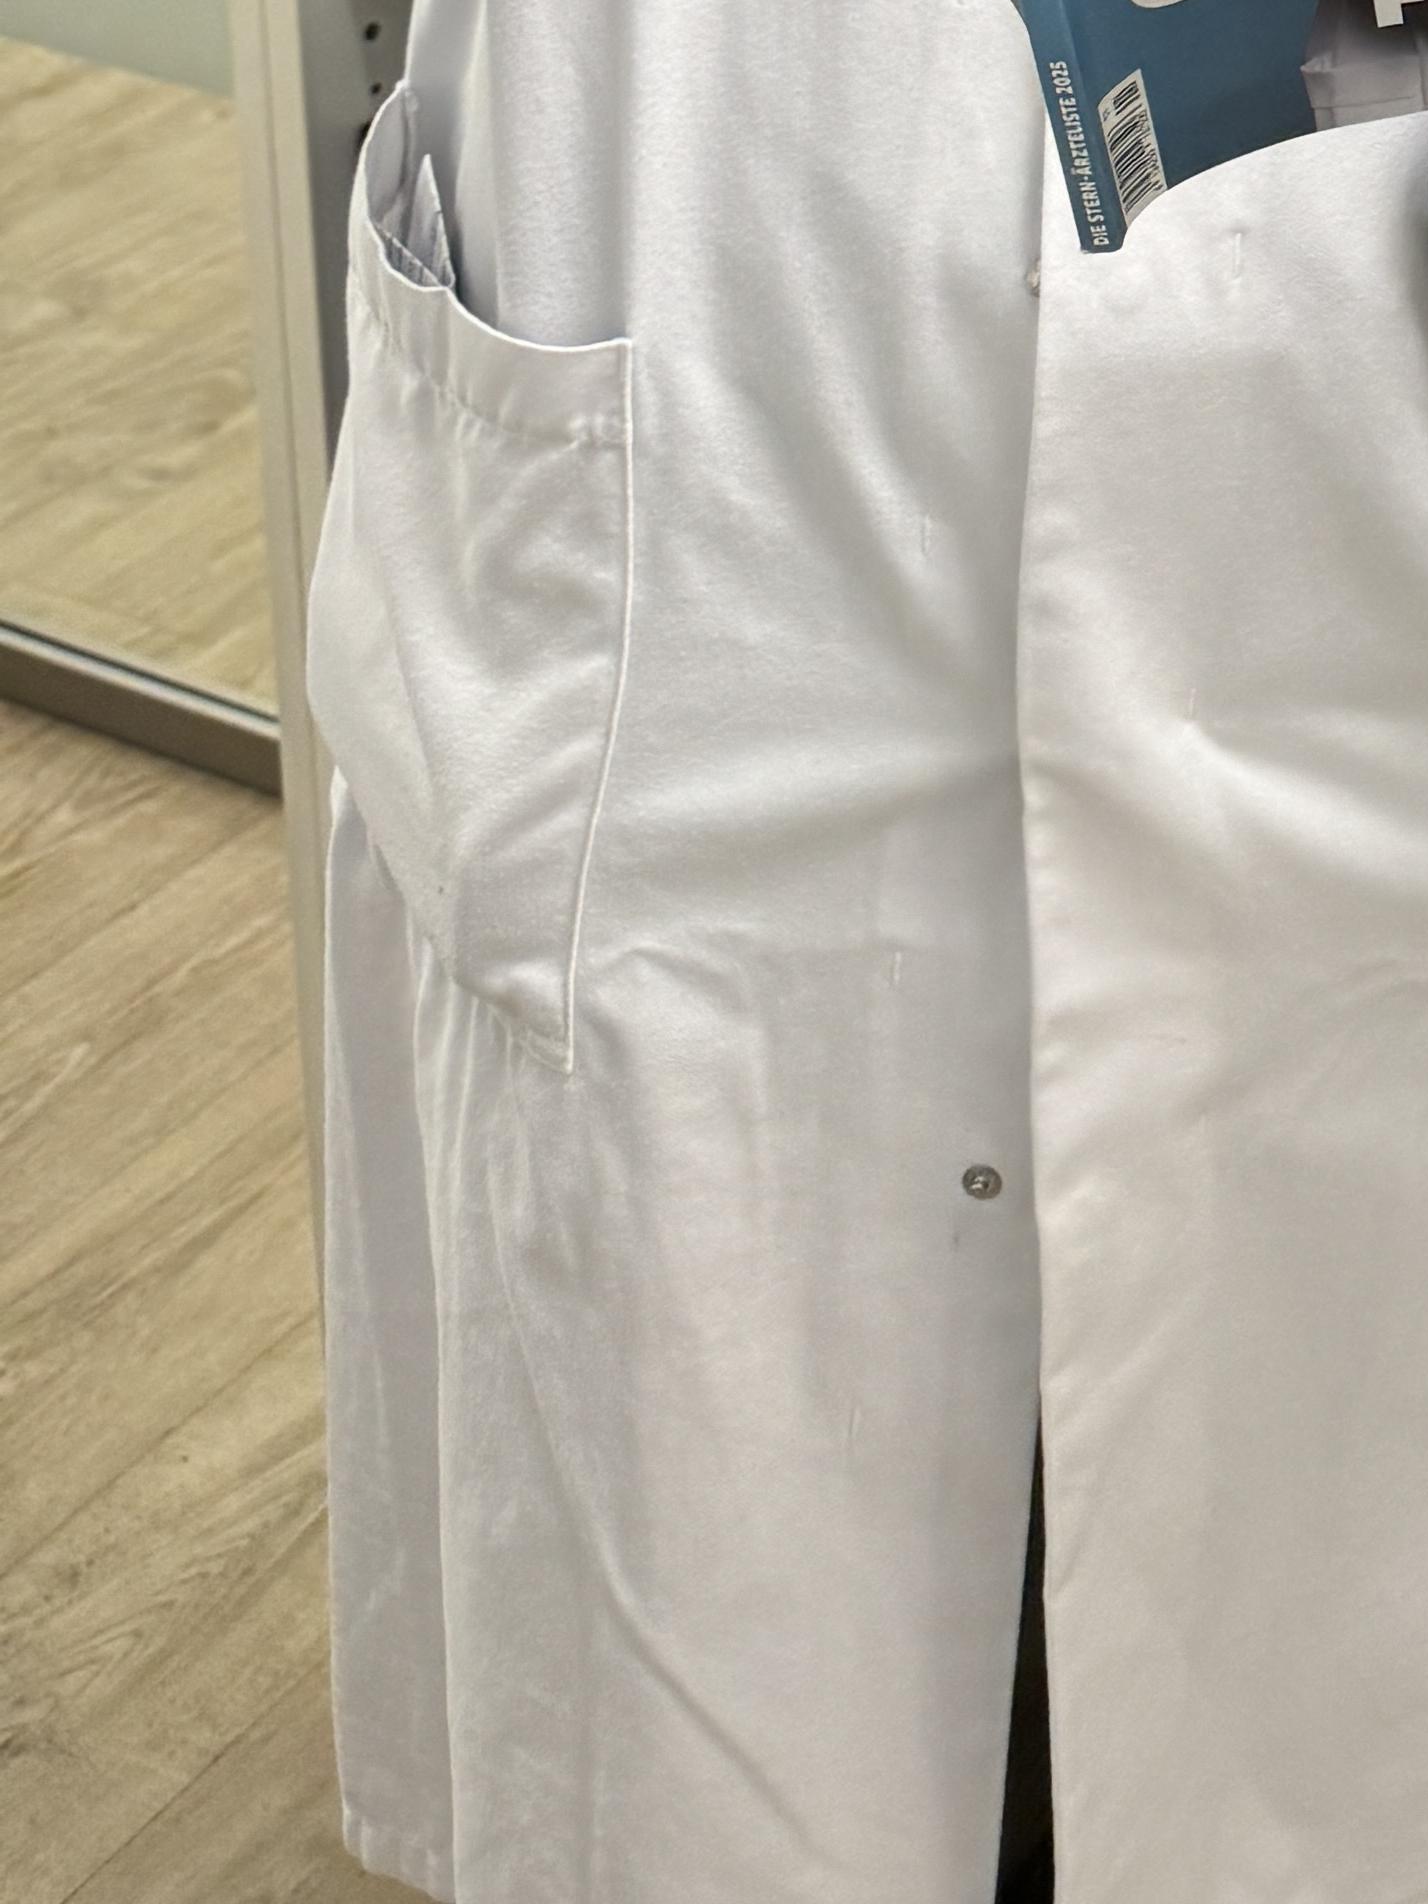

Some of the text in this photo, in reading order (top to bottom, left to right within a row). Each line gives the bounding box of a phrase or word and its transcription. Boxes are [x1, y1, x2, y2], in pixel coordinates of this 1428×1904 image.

[1049, 60, 1109, 245] DIE STERN-ÄRZTELISTE 2025
